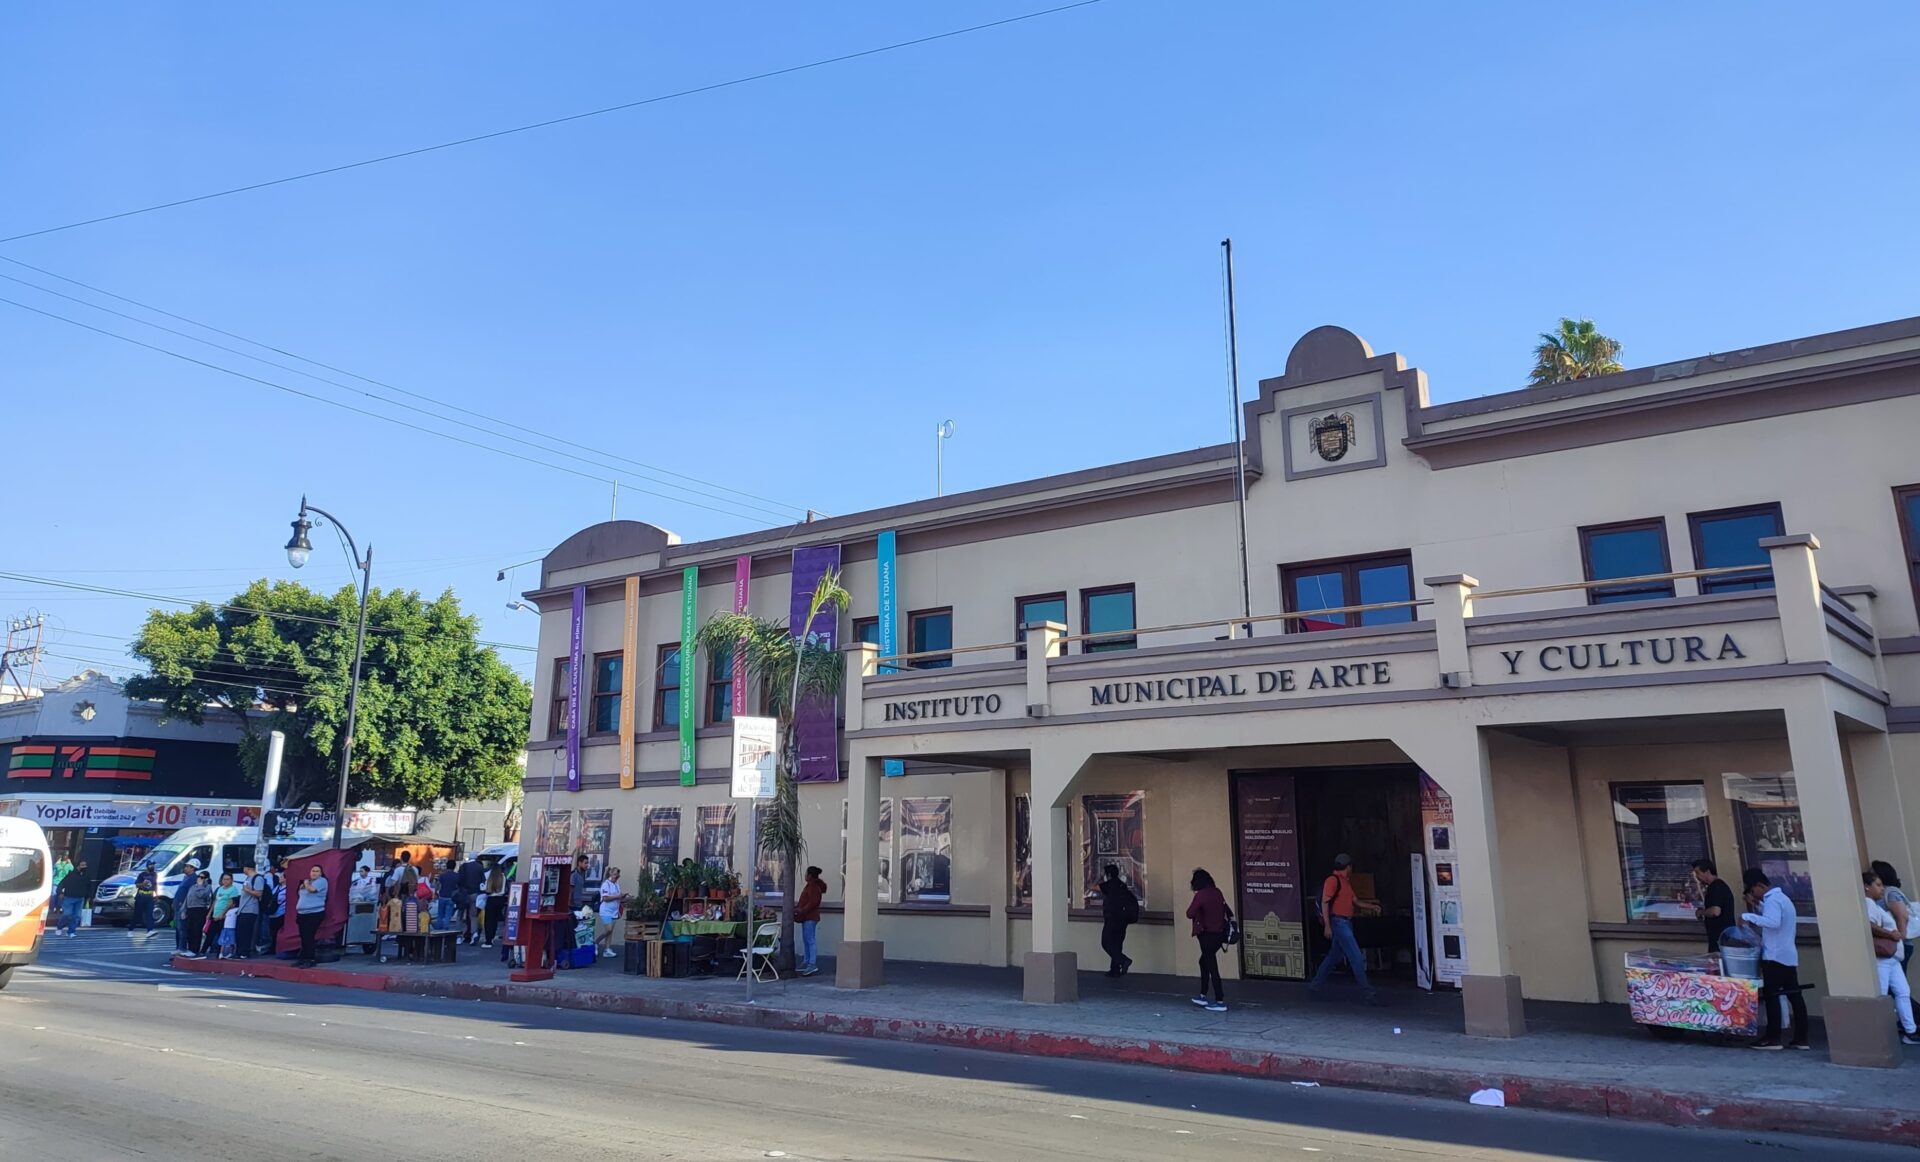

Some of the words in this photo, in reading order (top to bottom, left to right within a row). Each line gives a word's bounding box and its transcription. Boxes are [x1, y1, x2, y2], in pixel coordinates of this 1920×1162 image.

[686, 605, 691, 615] DE
[883, 600, 890, 611] DE
[684, 678, 690, 686] LA
[736, 677, 742, 689] DE
[884, 693, 1002, 722] INSTITUTO
[1090, 674, 1246, 707] MUNICIPAL
[1257, 669, 1296, 692] DE
[1308, 660, 1392, 690] ARTE
[1500, 650, 1524, 675] Y
[1539, 633, 1747, 672] CULTURA
[572, 685, 578, 695] LA
[684, 688, 690, 698] DE
[572, 697, 577, 708] DE
[36, 804, 93, 821] Yoplait
[146, 804, 180, 825] $10
[544, 856, 572, 865] TELNOR
[1643, 974, 1715, 1001] Dulces
[1719, 988, 1738, 1011] y
[1645, 998, 1733, 1027] Botanas
